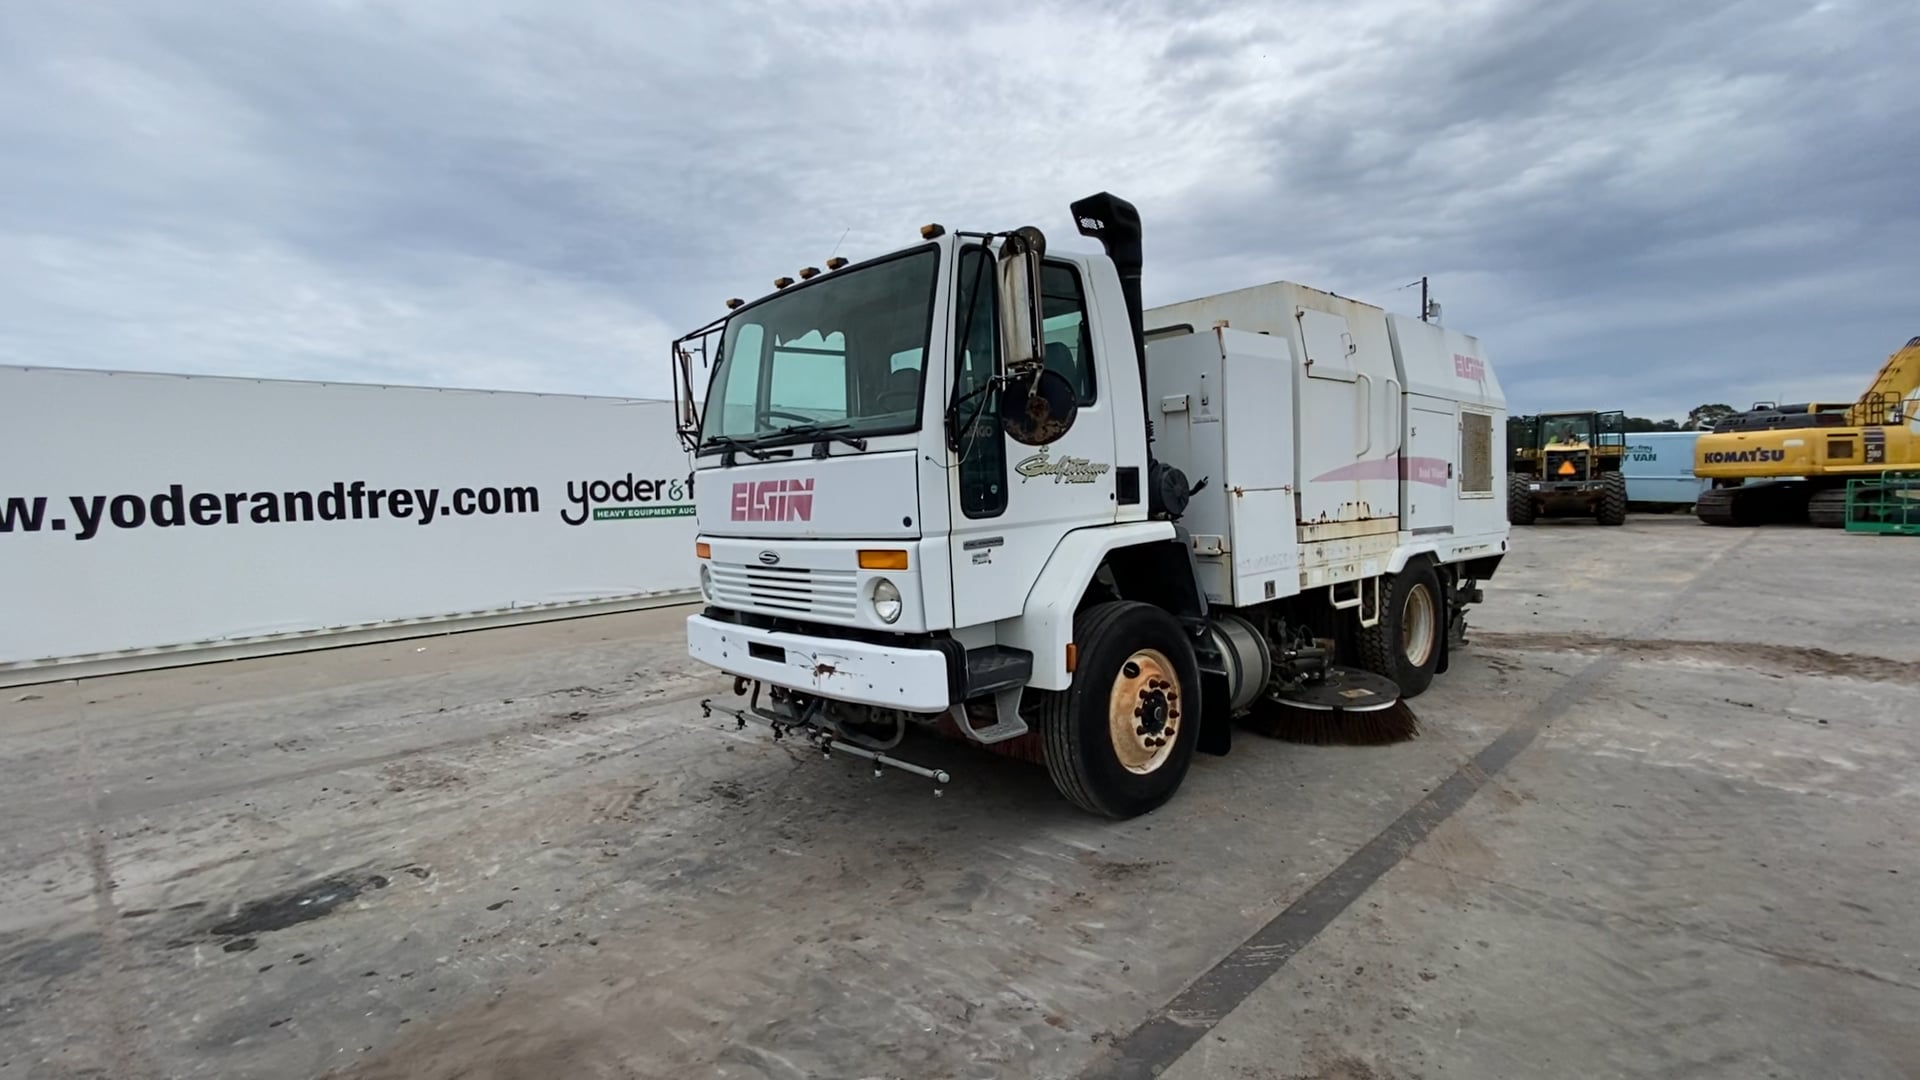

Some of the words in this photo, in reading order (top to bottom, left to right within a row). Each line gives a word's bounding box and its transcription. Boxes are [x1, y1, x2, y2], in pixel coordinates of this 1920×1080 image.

[1633, 453, 1657, 462] VAN
[1704, 448, 1785, 464] KOMATSU
[730, 477, 815, 522] ELGIN
[597, 508, 626, 518] HEAVY
[628, 507, 676, 517] EQUIPMENT
[678, 507, 696, 515] AUC
